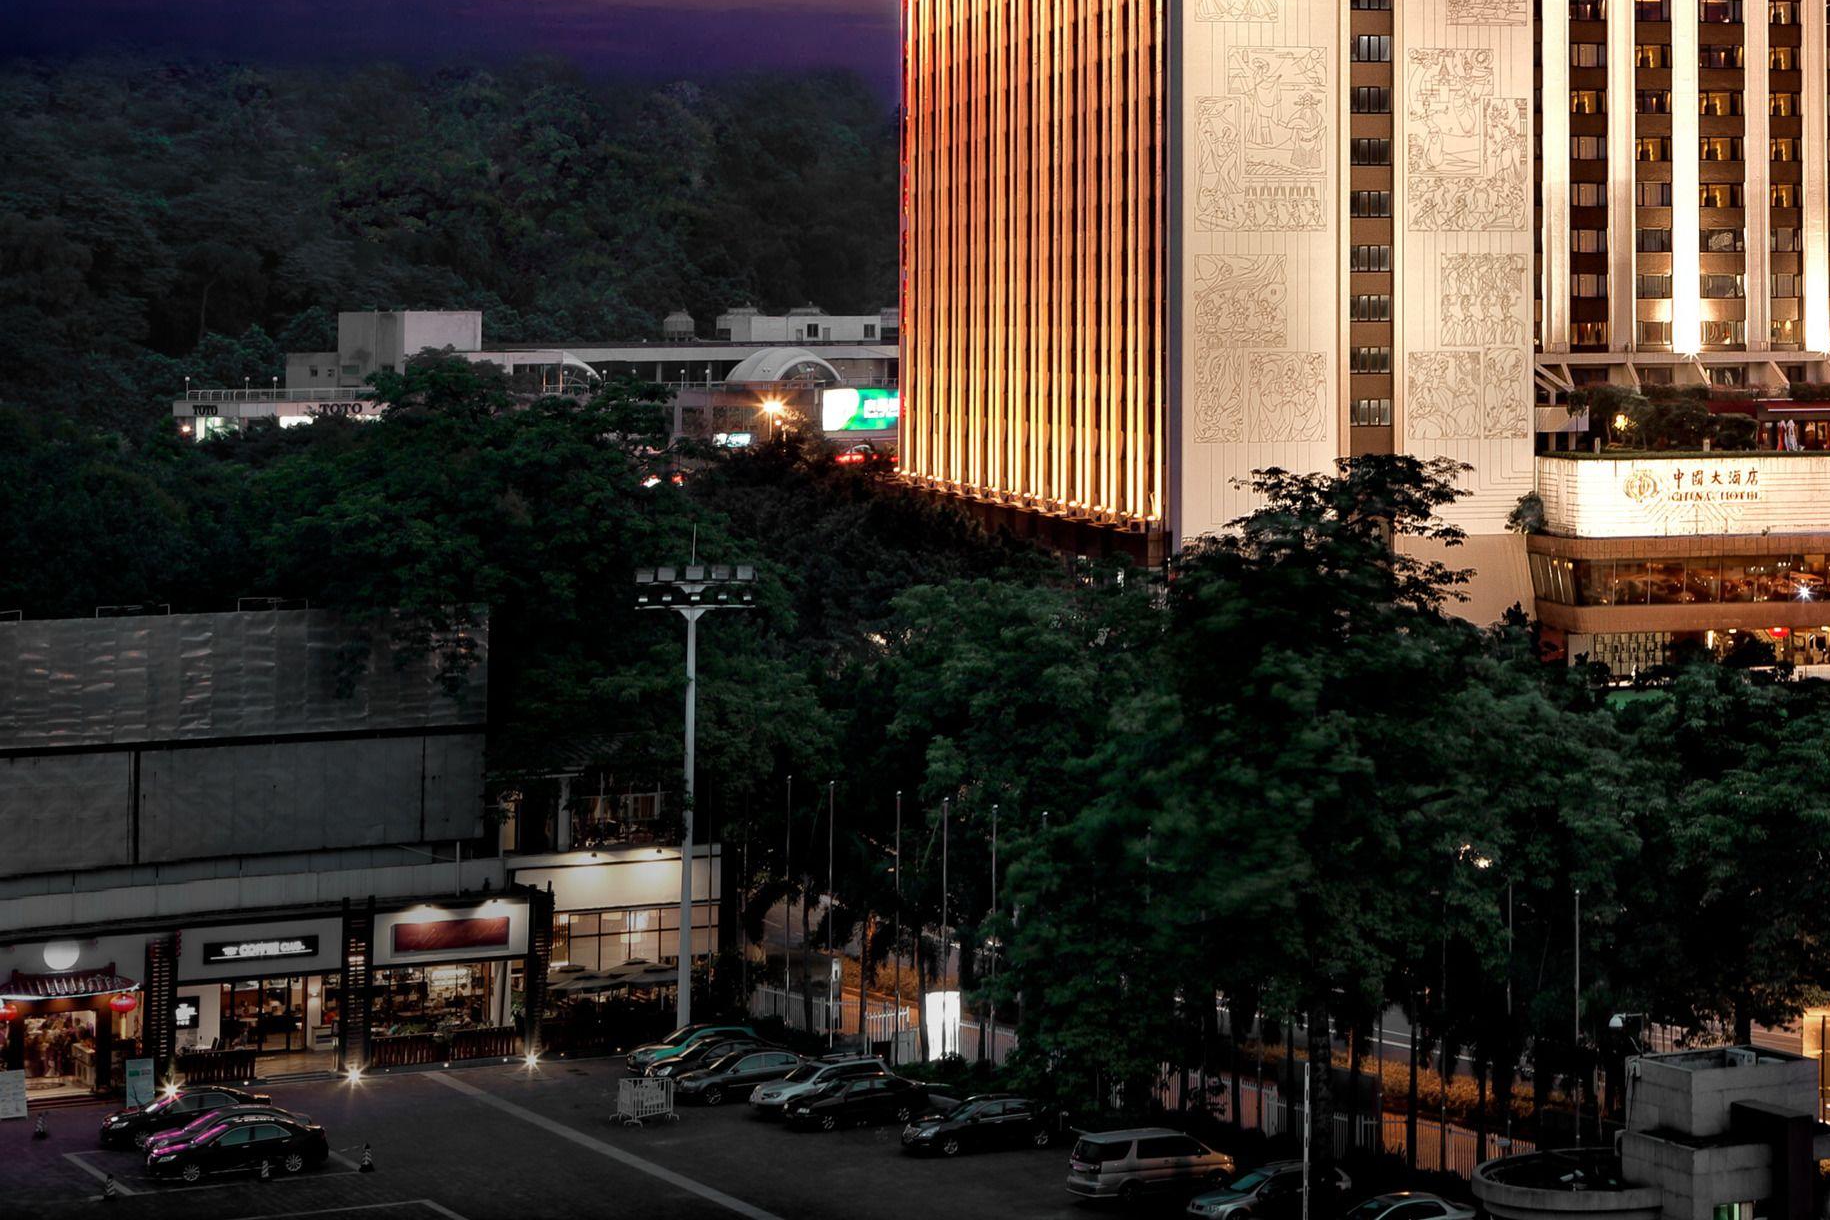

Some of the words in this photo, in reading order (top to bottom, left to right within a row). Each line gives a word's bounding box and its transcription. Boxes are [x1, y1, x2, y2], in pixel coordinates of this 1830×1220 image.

[193, 404, 218, 416] TOTO
[319, 402, 363, 415] TOTO
[1671, 491, 1714, 502] CHINA
[1720, 491, 1761, 501] HOTEL
